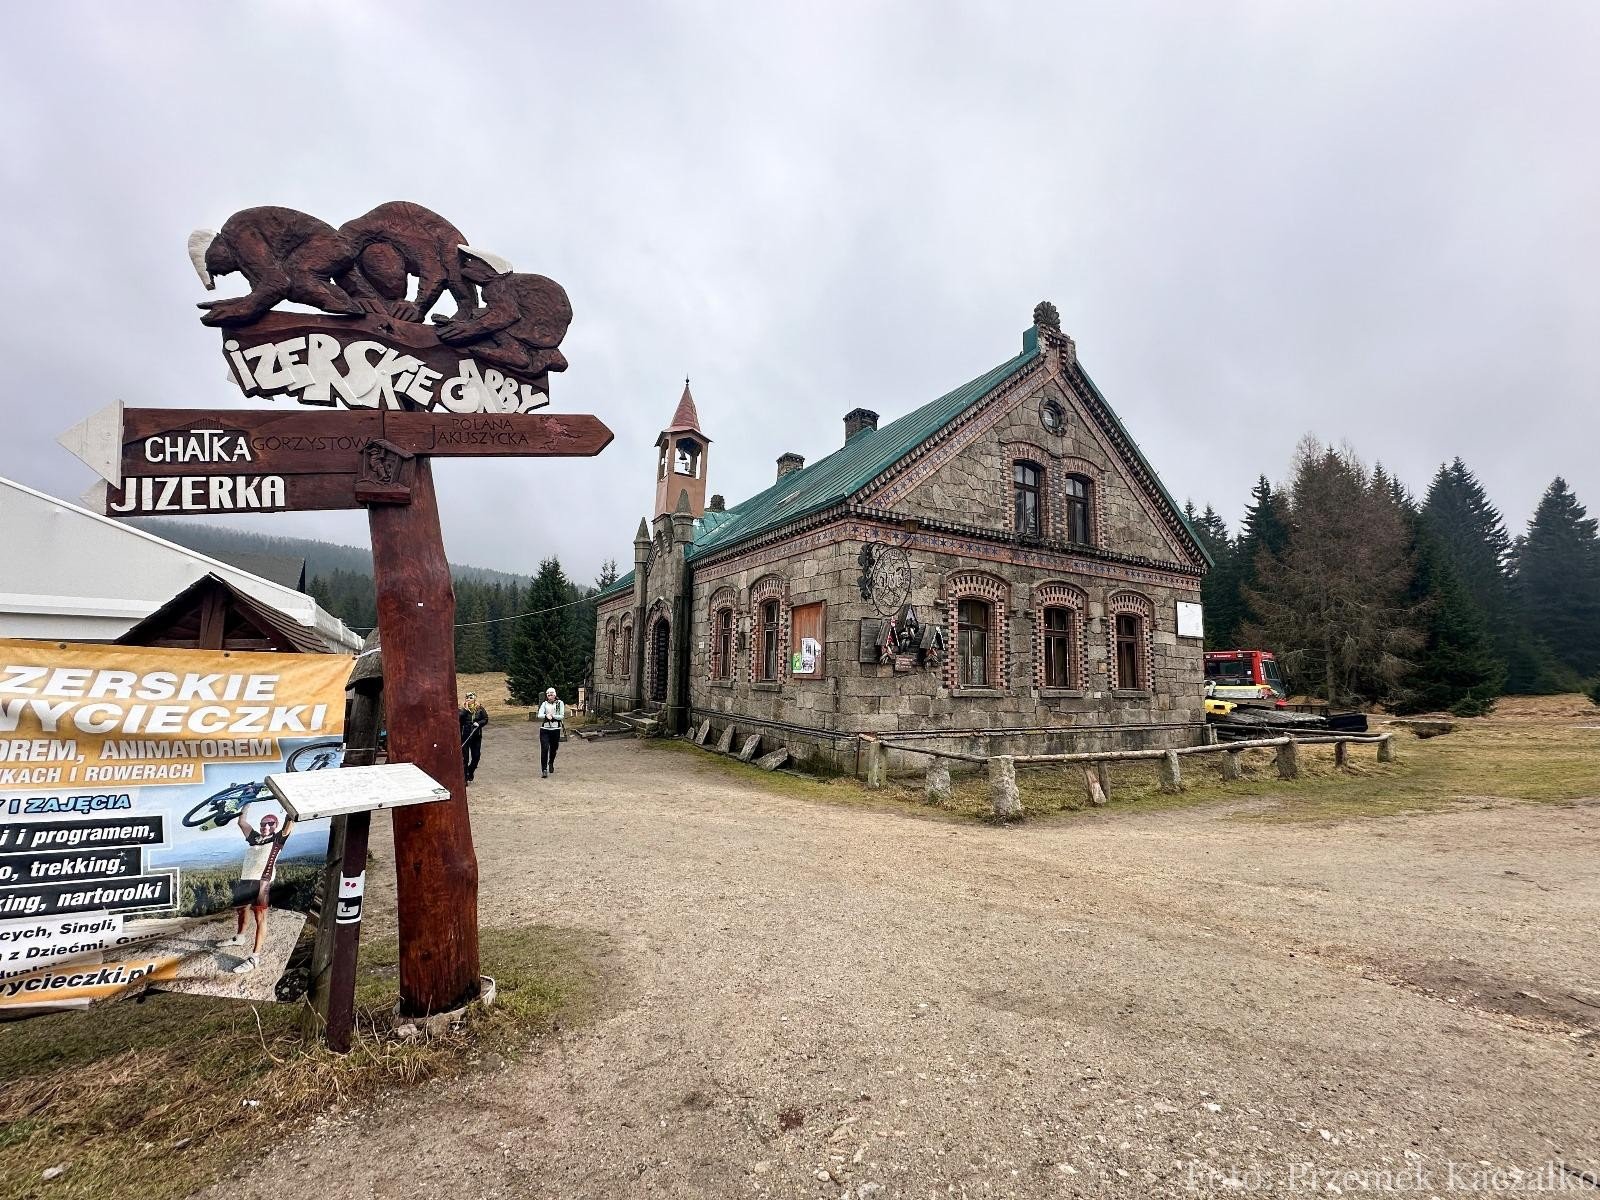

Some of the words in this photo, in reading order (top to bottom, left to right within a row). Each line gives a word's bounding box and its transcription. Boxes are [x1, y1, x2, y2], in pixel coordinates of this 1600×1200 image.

[452, 418, 514, 431] POLANA
[145, 429, 252, 463] CHATKA
[428, 424, 529, 449] JAKUSZYCKA
[110, 476, 286, 512] JIZERKA
[0, 665, 280, 701] ZERSKIE
[99, 738, 272, 760] ANIMATOREM
[0, 767, 62, 784] KACH
[69, 767, 78, 782] I
[84, 763, 195, 782] ROWERACH
[24, 794, 131, 814] ZAJĘCIA
[15, 828, 27, 845] i
[30, 825, 155, 848] programem,
[30, 857, 126, 877] trekking,
[57, 882, 163, 907] nartorolki
[59, 919, 117, 934] Singli,
[0, 964, 154, 997] ycieczki.pl
